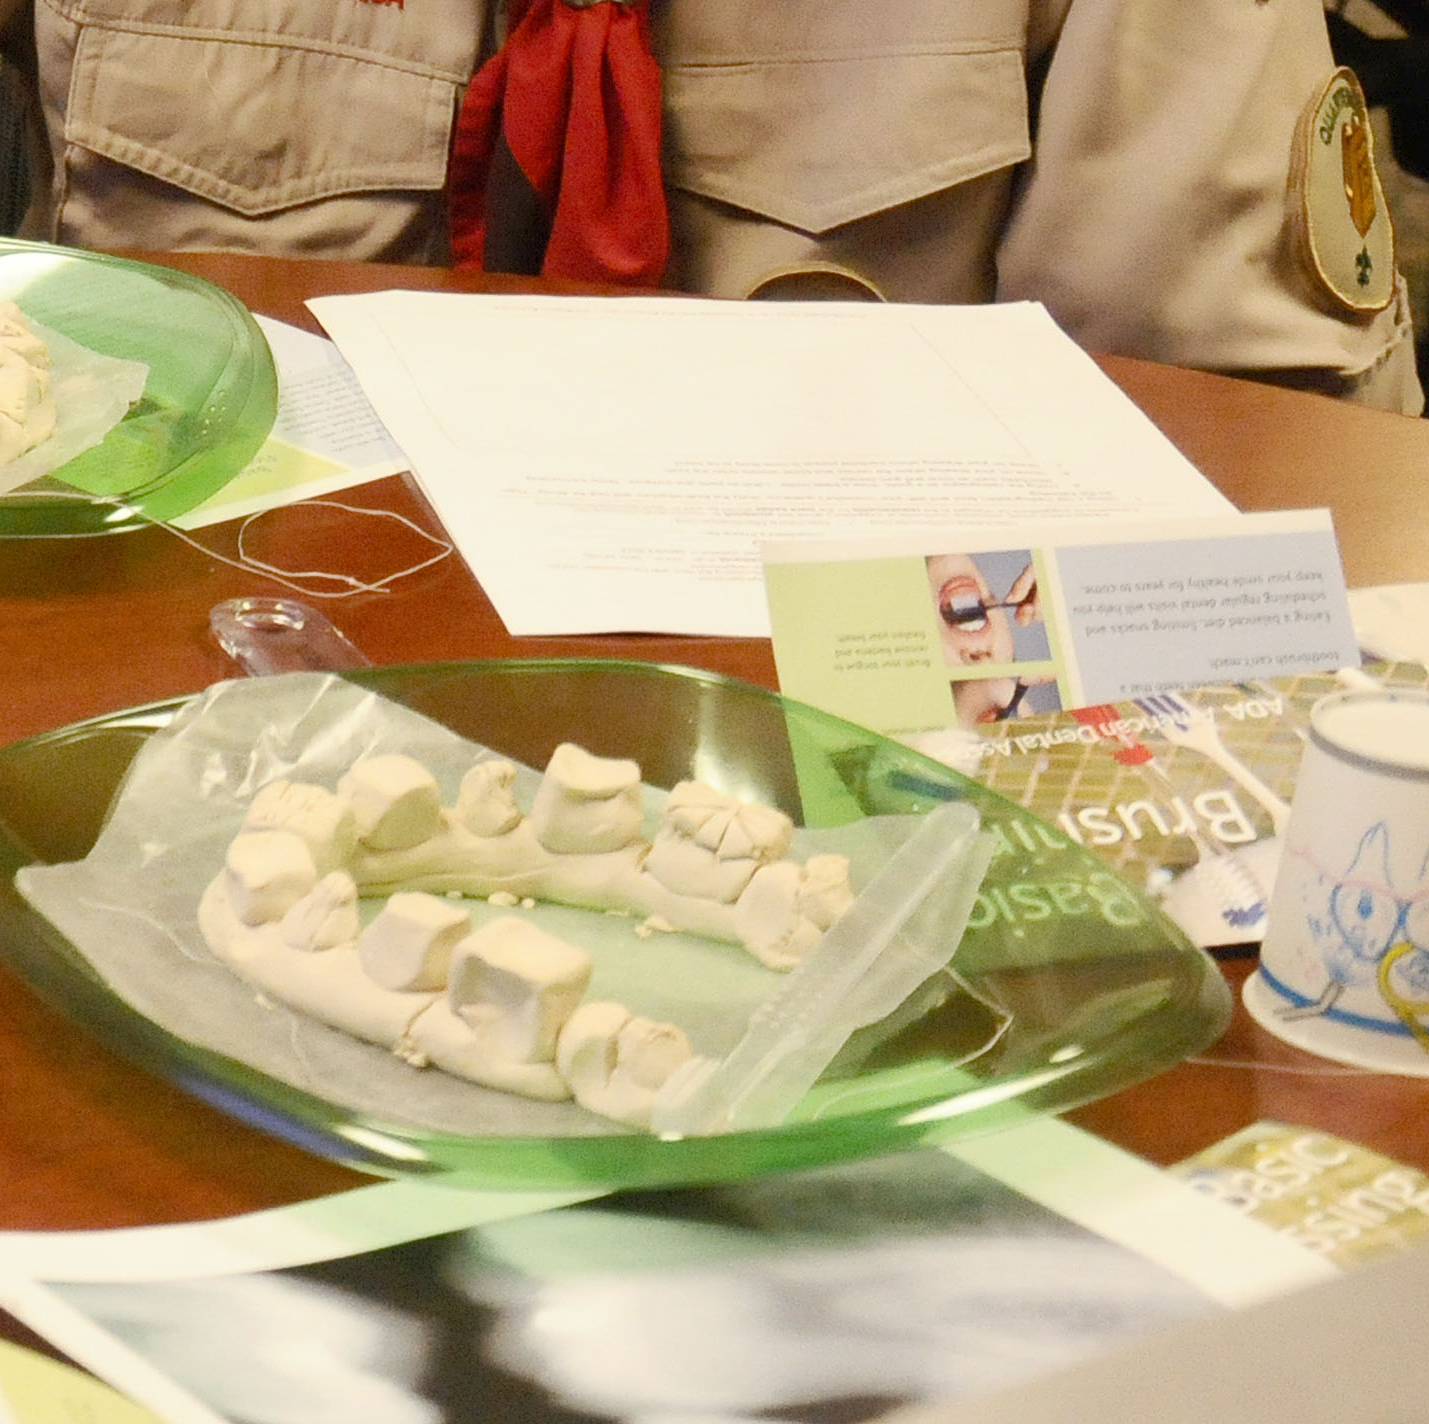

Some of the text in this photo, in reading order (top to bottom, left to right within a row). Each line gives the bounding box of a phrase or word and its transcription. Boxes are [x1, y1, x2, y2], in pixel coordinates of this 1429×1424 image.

[1232, 574, 1263, 588] smile
[1267, 570, 1291, 585] your
[1295, 569, 1323, 582] keep
[1135, 579, 1163, 592] years
[1168, 579, 1184, 592] for
[1187, 576, 1229, 590] healthy
[1072, 590, 1326, 617] scheduling regular dental visits will help you
[1229, 614, 1280, 628] balanced
[1293, 610, 1331, 623] Eating
[1085, 625, 1107, 637] and
[1111, 623, 1149, 635] snacks
[1275, 652, 1339, 665] toothbrush
[1224, 696, 1285, 722] ADA
[1014, 724, 1101, 757] Dental
